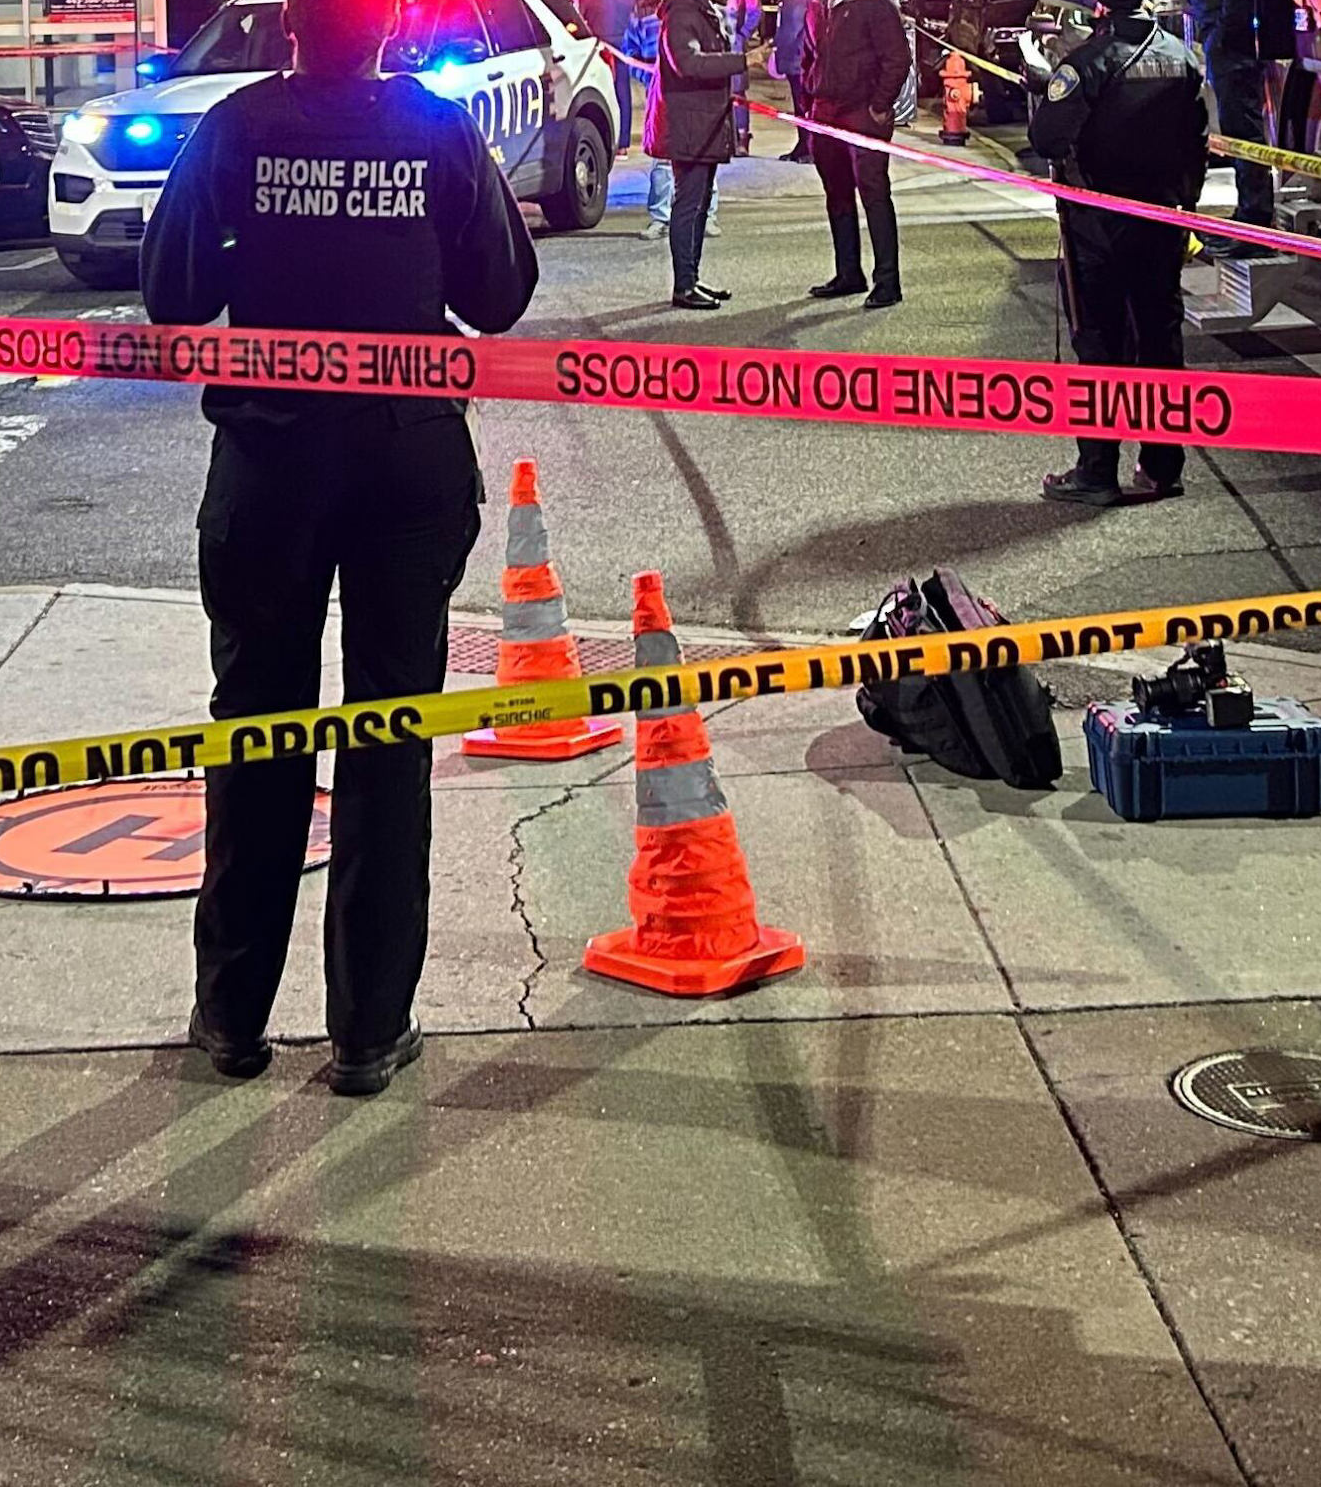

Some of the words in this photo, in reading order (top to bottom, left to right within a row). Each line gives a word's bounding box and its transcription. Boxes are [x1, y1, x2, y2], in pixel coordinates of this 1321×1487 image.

[256, 156, 345, 188] DRONE
[352, 160, 428, 188] PILOT
[255, 186, 337, 215] STAND
[345, 189, 426, 217] CLEAR
[94, 330, 160, 374] NOT
[170, 334, 220, 376] DO
[229, 336, 349, 384] SCENE
[358, 342, 476, 390] CRIME
[556, 350, 700, 403] CROSS
[713, 357, 801, 409] NOT
[819, 361, 877, 416] DO
[892, 368, 1054, 426] SCENE
[1069, 379, 1234, 437] CRIME
[589, 665, 786, 716] POLICE
[807, 645, 926, 690] LINE
[947, 636, 1021, 673] DO
[1039, 622, 1144, 660] NOT
[83, 734, 205, 785] NOT
[229, 706, 424, 767] CROSS
